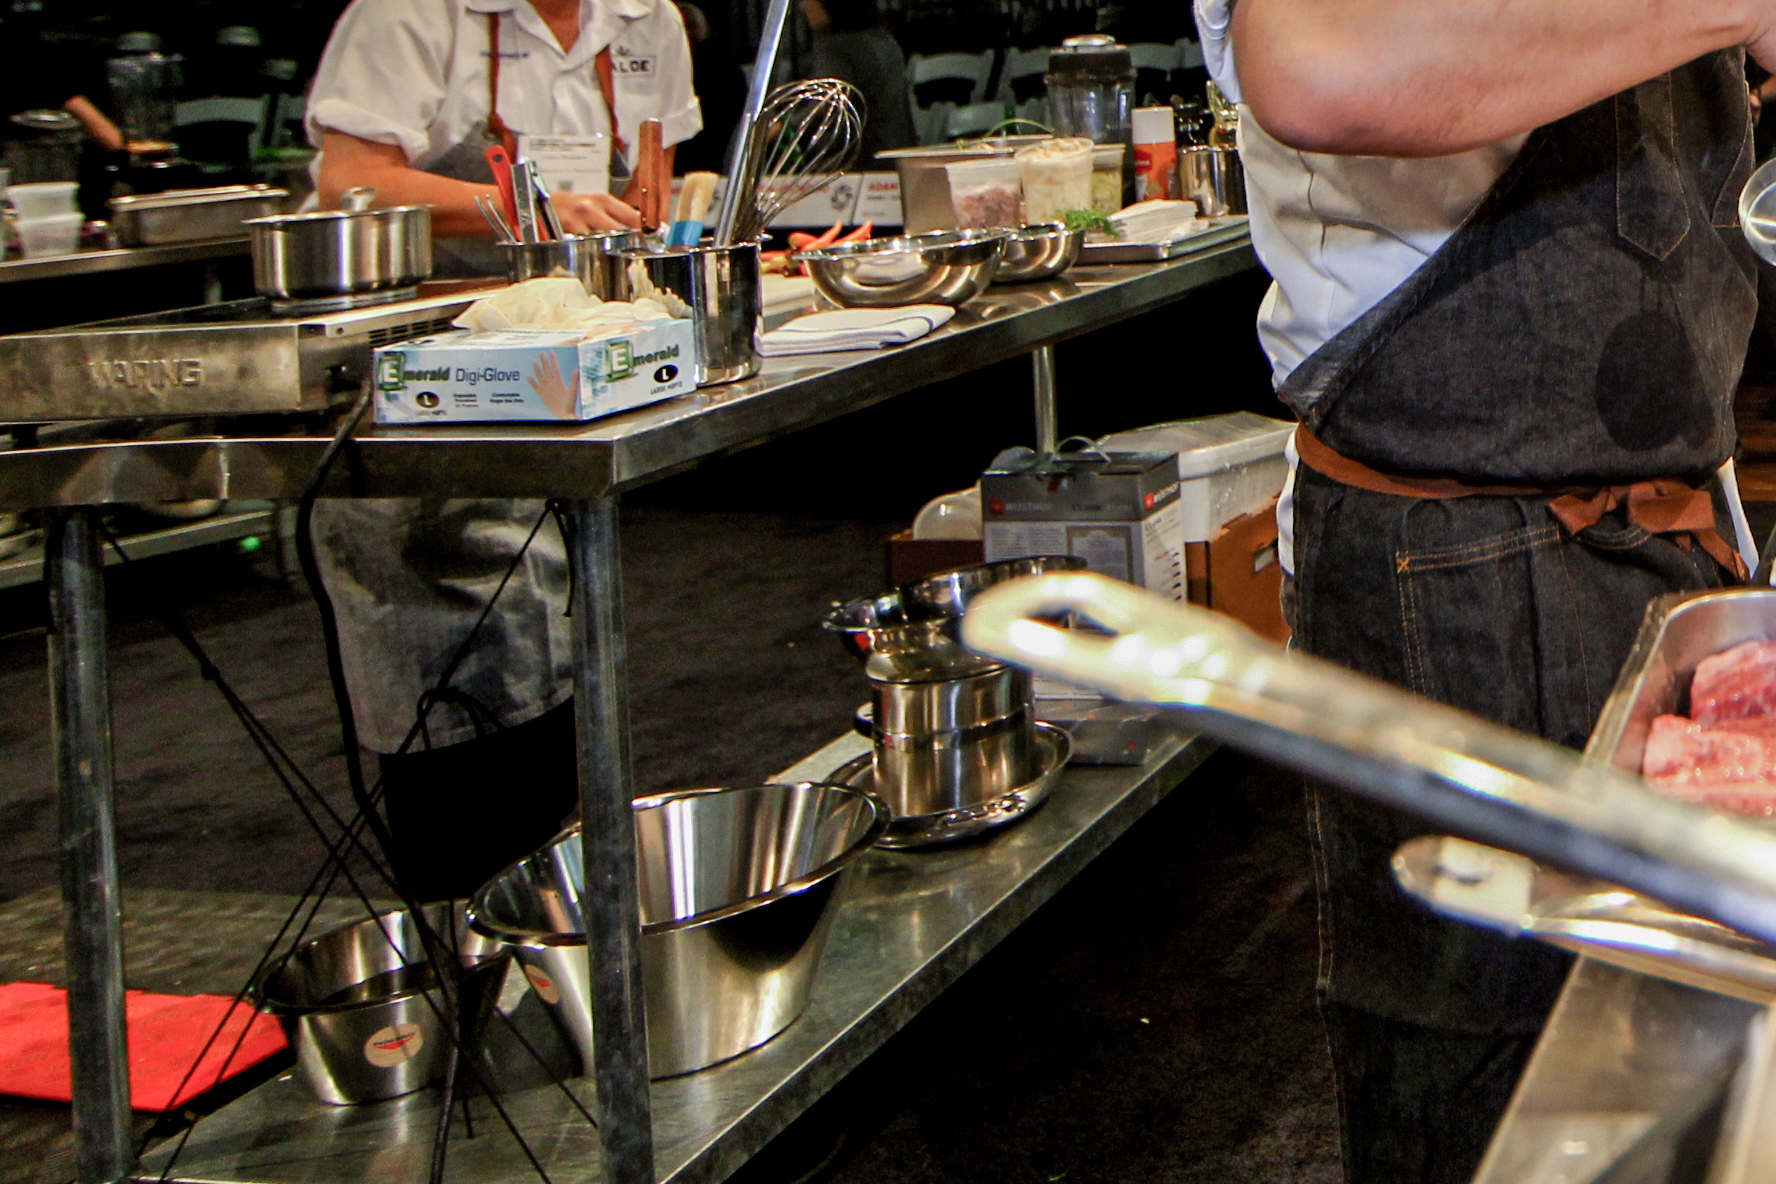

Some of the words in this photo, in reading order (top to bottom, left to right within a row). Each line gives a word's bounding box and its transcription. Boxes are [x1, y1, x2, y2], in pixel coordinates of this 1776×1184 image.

[381, 356, 450, 385] Emerald
[455, 367, 520, 385] Digi-Glove
[609, 342, 680, 373] Emerald
